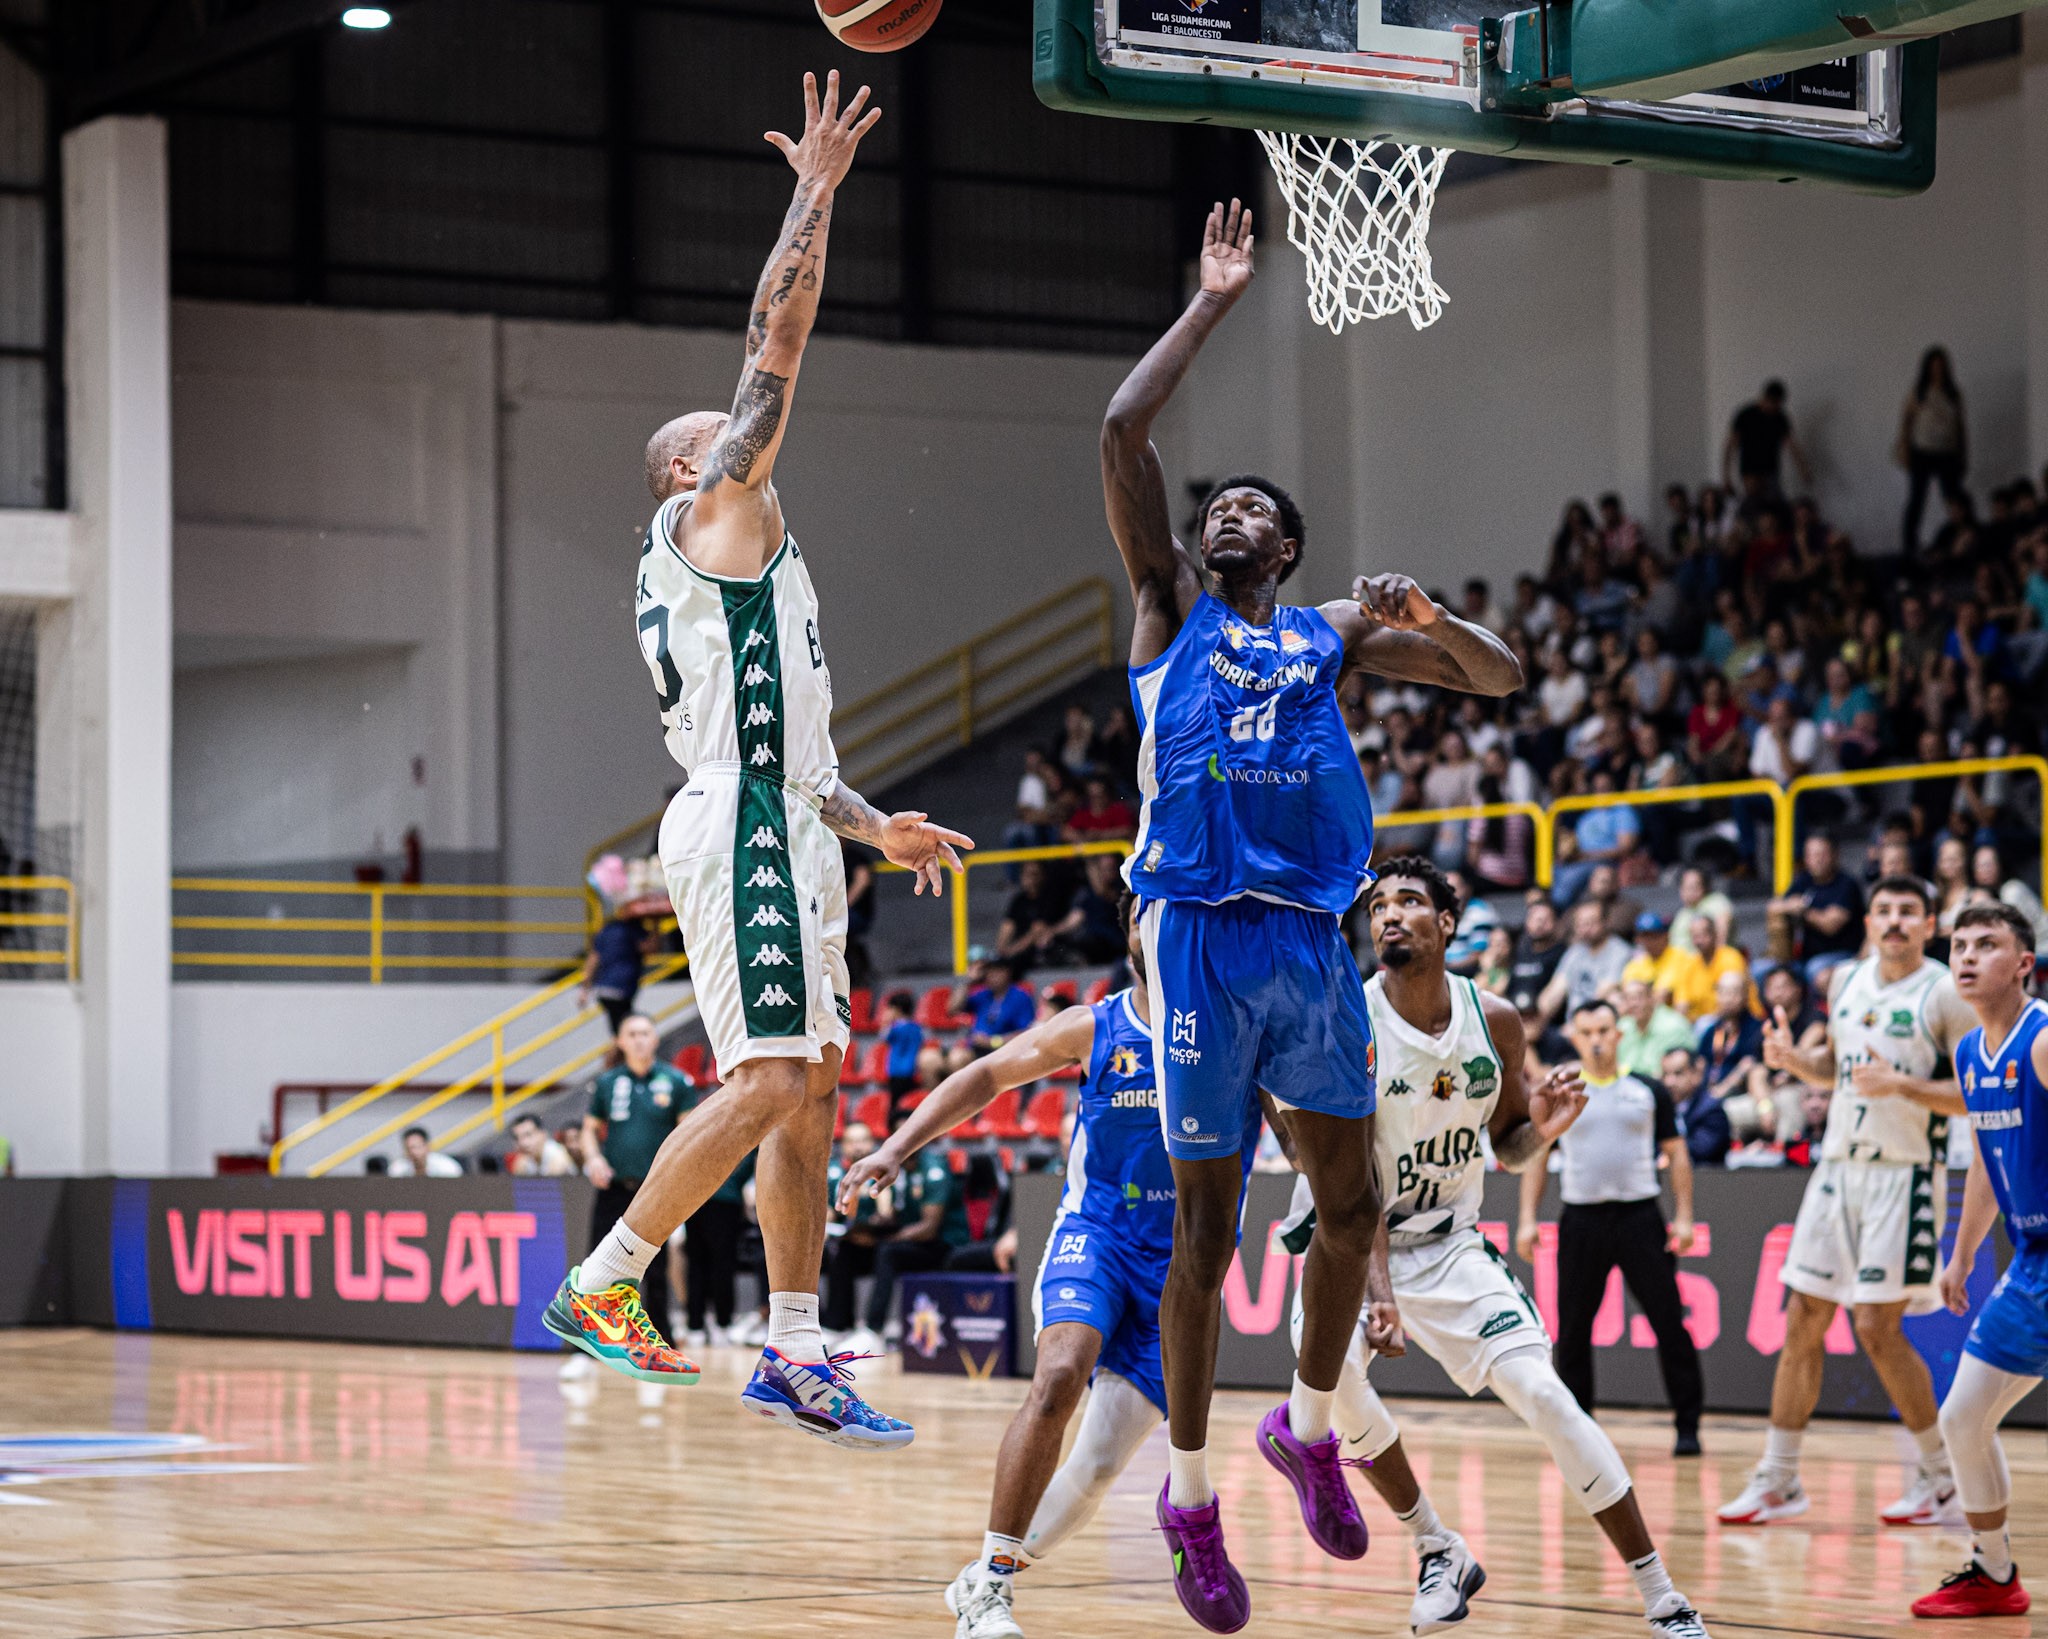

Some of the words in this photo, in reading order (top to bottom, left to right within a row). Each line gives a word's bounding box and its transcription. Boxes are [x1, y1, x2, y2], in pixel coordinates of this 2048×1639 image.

[1151, 11, 1170, 23] LIGA
[1170, 14, 1232, 30] SUDAMERICANA
[1161, 24, 1172, 35] DE
[1173, 26, 1222, 40] BALONCESTO
[1801, 84, 1811, 94] We
[1811, 86, 1823, 96] Are
[1822, 87, 1851, 99] Basketball
[1226, 765, 1267, 785] ANCO
[1111, 1089, 1159, 1109] JORG
[1855, 1105, 1868, 1133] 7
[1146, 1189, 1178, 1202] BAN
[1414, 1178, 1441, 1211] 11
[166, 1208, 326, 1299] VISIT
[332, 1209, 431, 1303] US
[440, 1211, 538, 1307] AT
